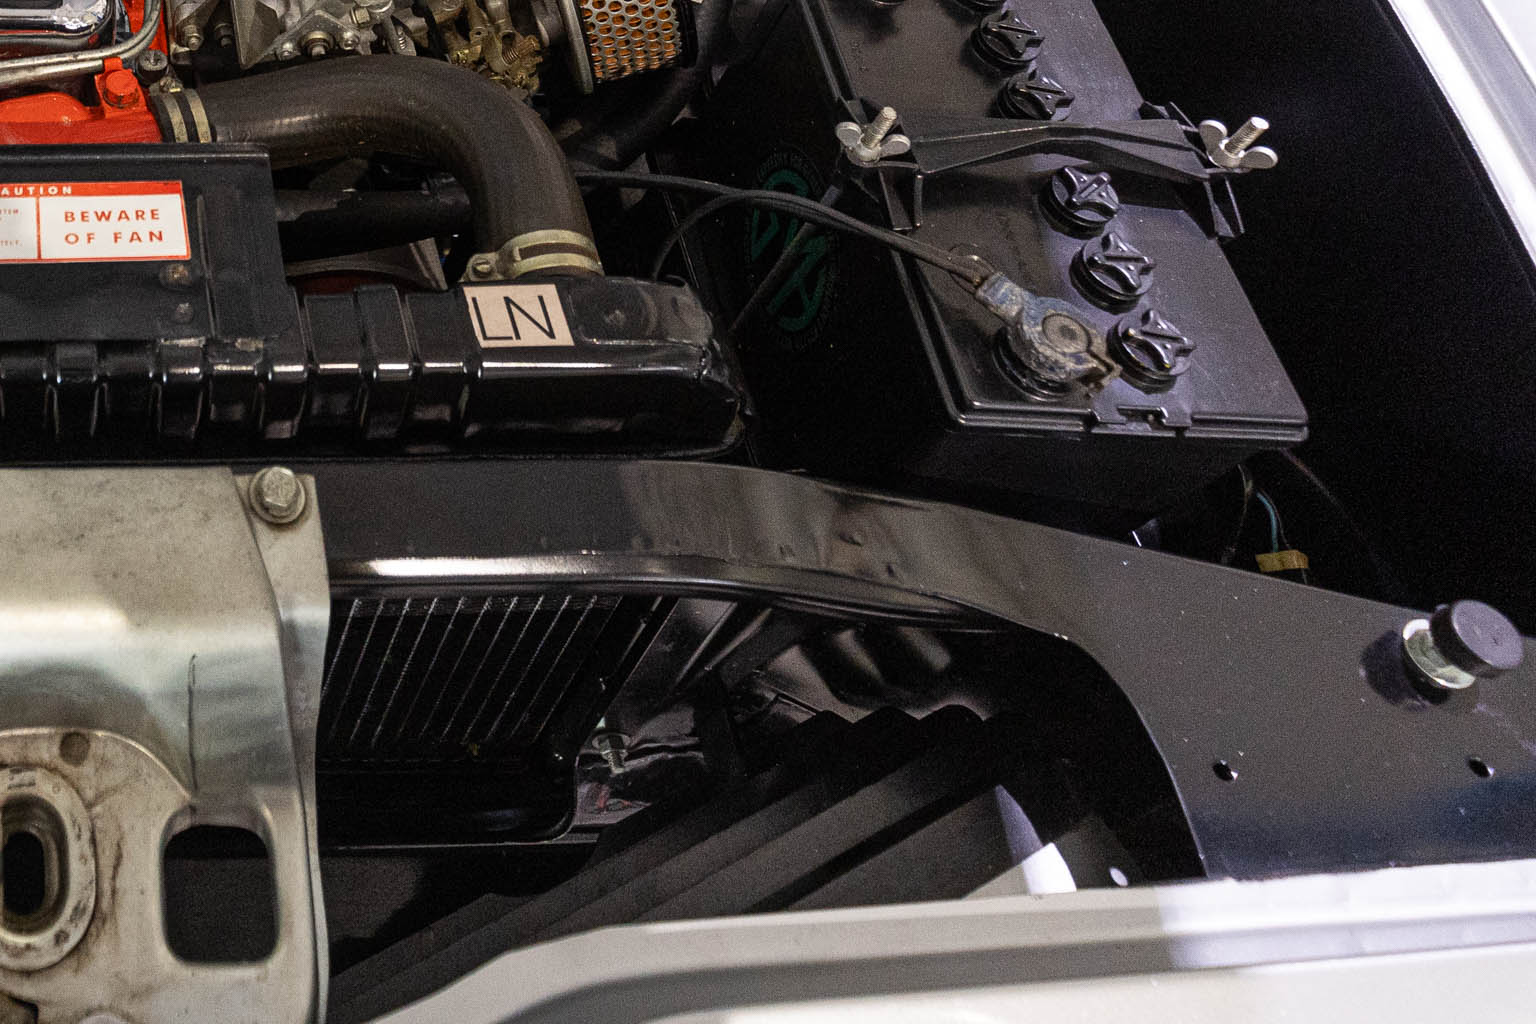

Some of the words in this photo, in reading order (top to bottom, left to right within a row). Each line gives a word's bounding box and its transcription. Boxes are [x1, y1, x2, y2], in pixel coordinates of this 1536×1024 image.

[64, 208, 161, 223] BEWARE
[64, 232, 97, 245] OF
[113, 230, 164, 244] FAN
[472, 295, 556, 340] LN
